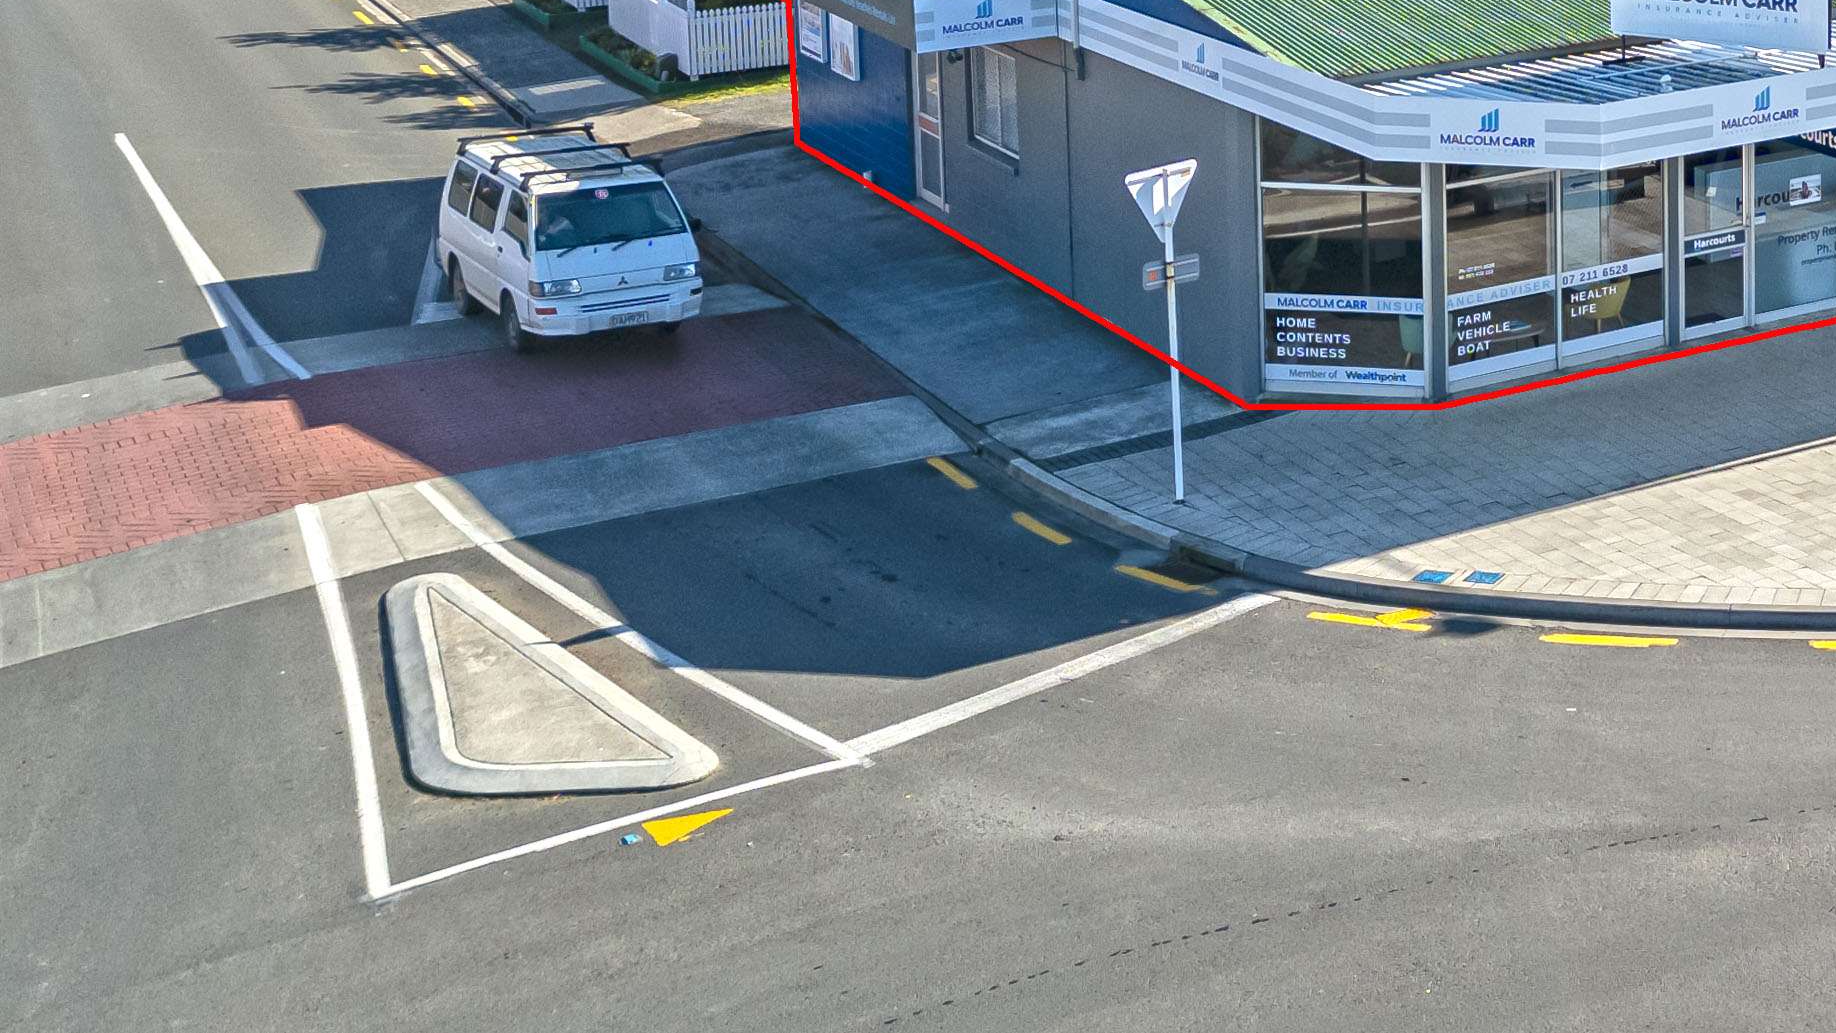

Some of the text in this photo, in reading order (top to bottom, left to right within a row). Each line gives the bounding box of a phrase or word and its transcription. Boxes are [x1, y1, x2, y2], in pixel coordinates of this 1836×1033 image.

[1637, 4, 1722, 17] INSURANCE
[942, 20, 995, 34] MALCOLM
[996, 17, 1024, 27] CARR
[1722, 113, 1771, 130] MALCOLM
[1772, 109, 1799, 122] CARR
[1440, 134, 1536, 148] MALCOLM CARR
[1694, 233, 1736, 250] Harcourts
[1777, 228, 1820, 247] Property
[1562, 264, 1629, 286] 07 211 6528
[1490, 279, 1552, 299] ADVISER
[1570, 286, 1617, 303] HEALTH
[1277, 297, 1335, 309] MALCOLM
[1336, 299, 1368, 310] CARR
[1571, 304, 1597, 317] LIFE
[1276, 317, 1316, 329] HOME
[1457, 310, 1491, 327] FARM
[1276, 332, 1351, 344] CONTENTS
[1457, 321, 1511, 341] VEHICLE
[1276, 346, 1346, 359] BUSINESS
[1457, 340, 1490, 356] BOAT
[1289, 369, 1407, 383] Member of Wealthpoint
